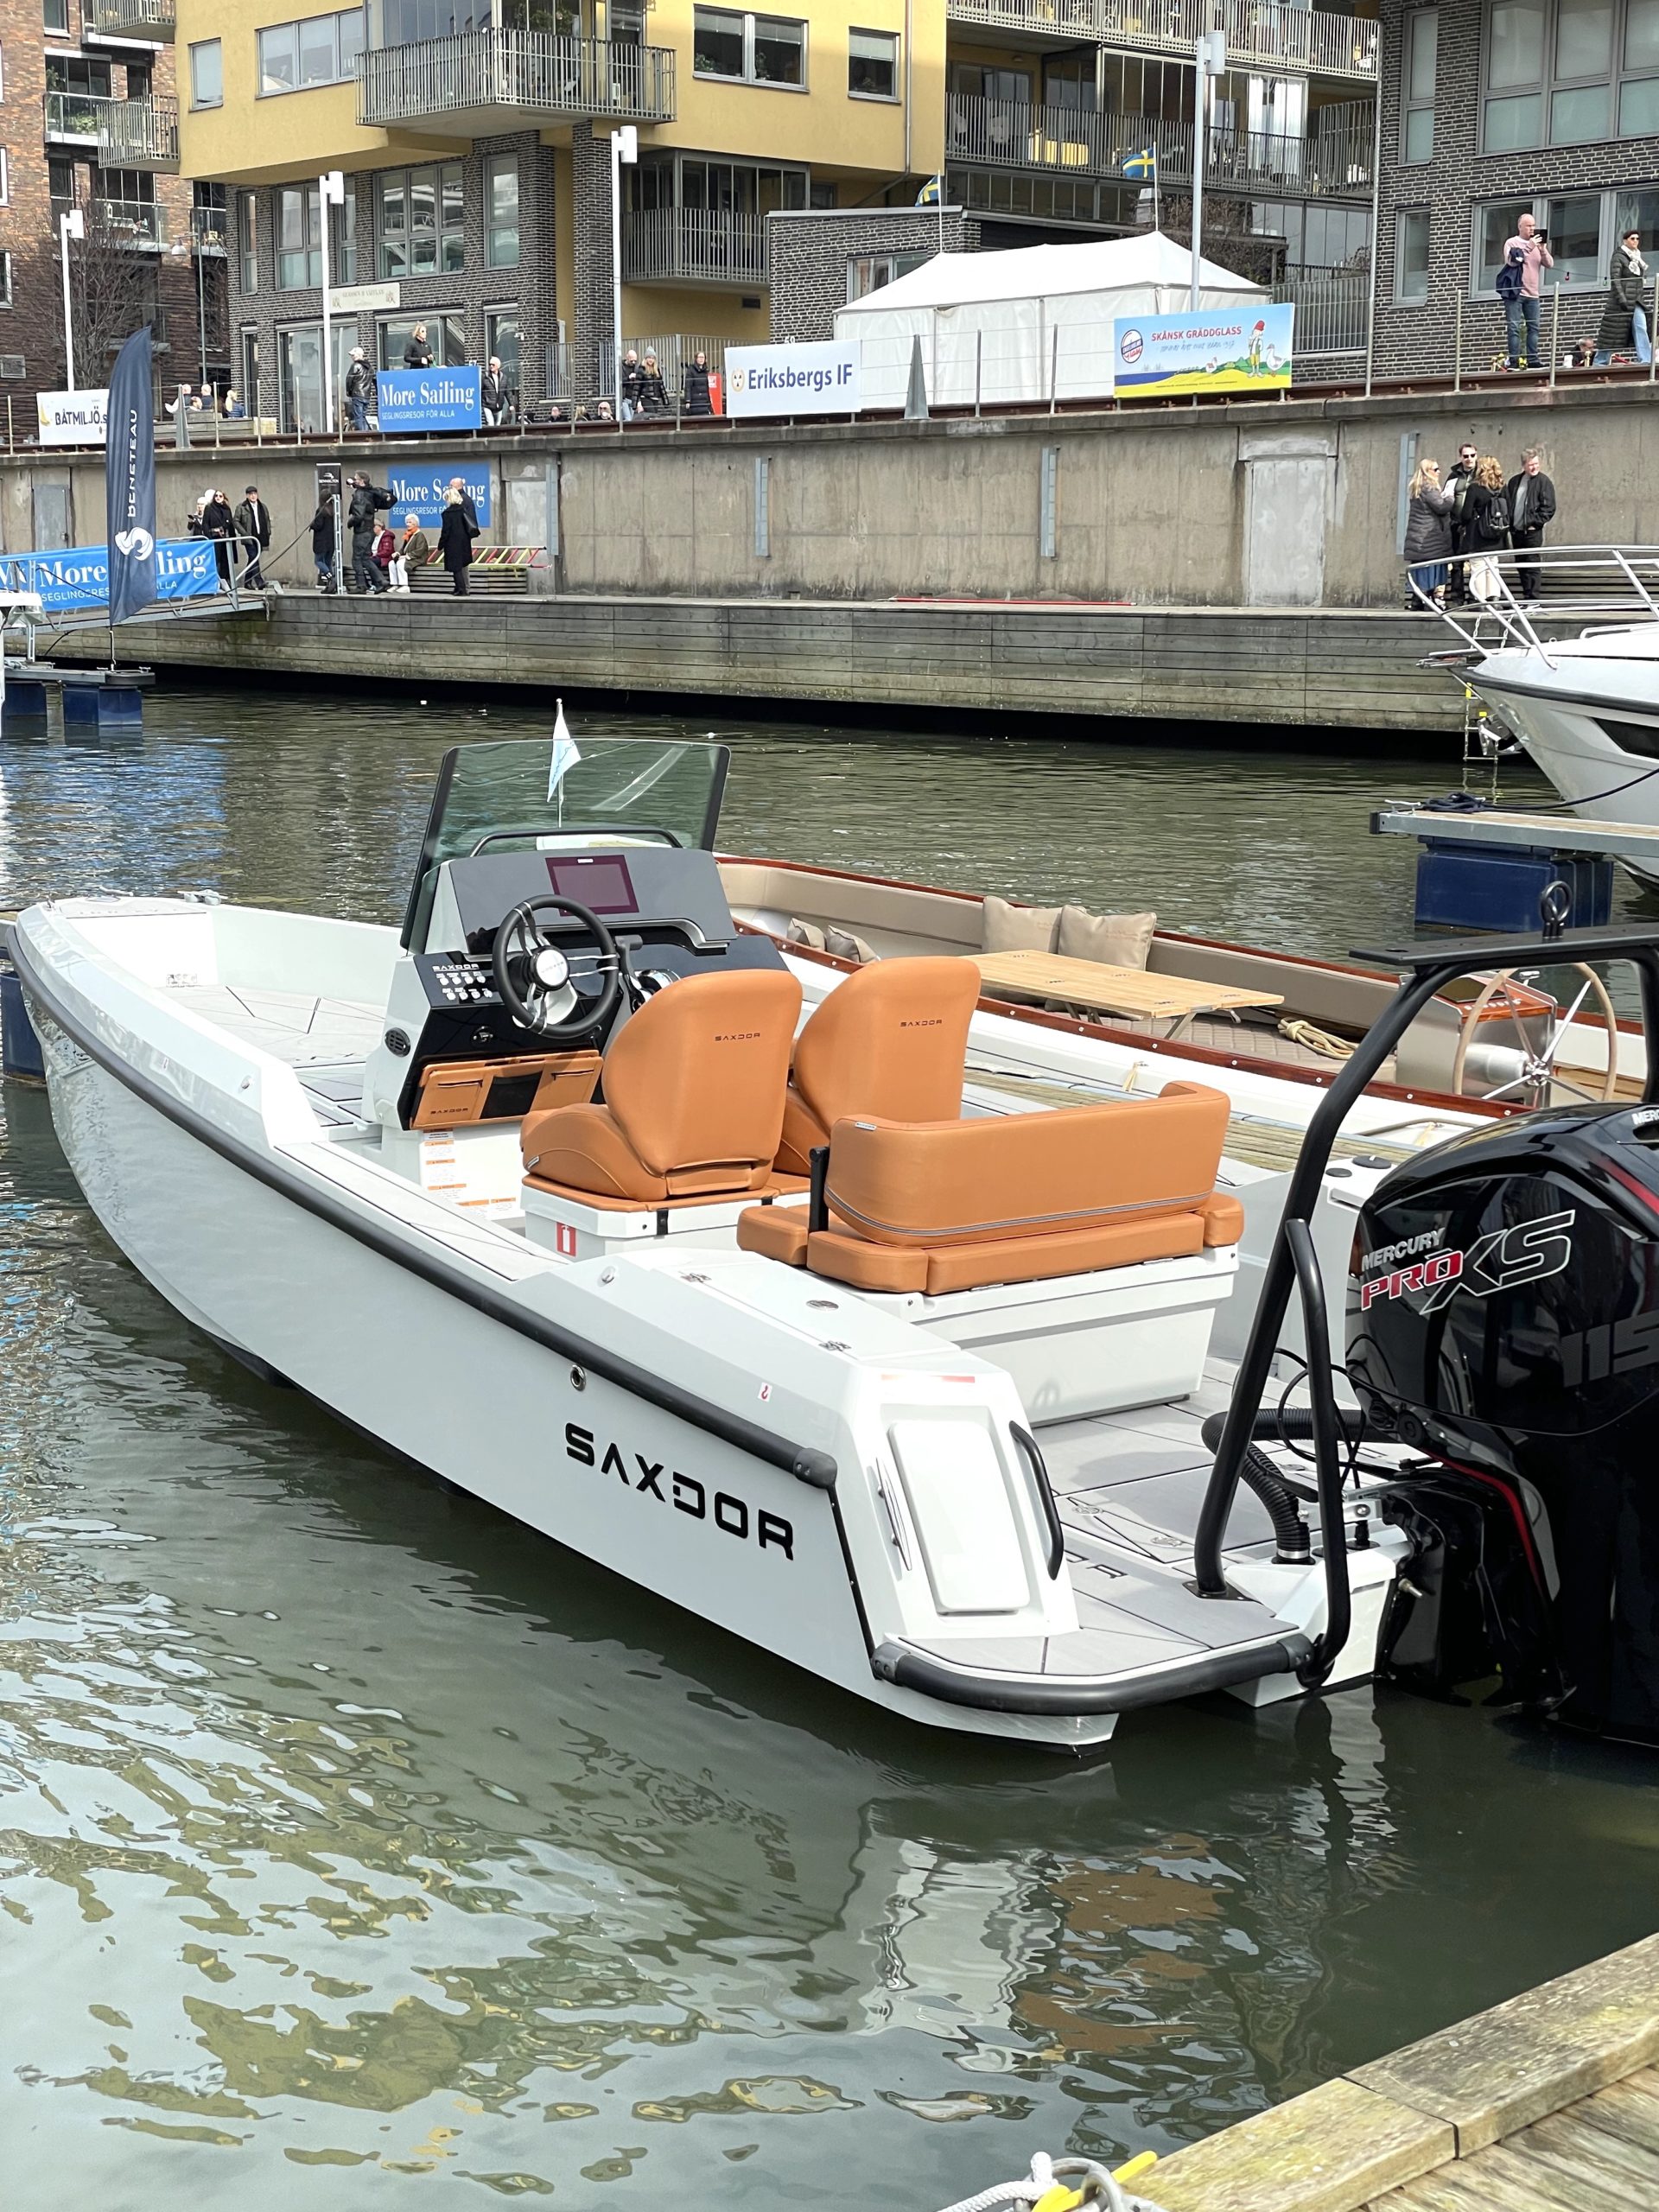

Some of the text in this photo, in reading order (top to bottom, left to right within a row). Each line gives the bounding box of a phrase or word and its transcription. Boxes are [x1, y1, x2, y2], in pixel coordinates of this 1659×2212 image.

[1151, 326, 1242, 341] SKÅNSK GRÄDDGLASS
[748, 364, 853, 392] Eriksbergs IF
[381, 380, 475, 411] More Sailing
[54, 405, 108, 426] BÅTMILJÖ.s
[382, 409, 455, 421] SEGLINGSRESOR FÖR ALLA
[127, 409, 137, 518] BENETEAU
[392, 480, 429, 502] More
[392, 506, 438, 515] SEGLINGSRESOR
[37, 561, 108, 588] More
[156, 550, 207, 580] ling
[41, 581, 178, 602] SEGLINGSRES LLA
[899, 1019, 943, 1027] SAXDOR
[715, 1033, 760, 1042] SAXDOR
[1362, 1227, 1446, 1272] MERCURY
[1361, 1209, 1576, 1316] PRO XS
[565, 1422, 794, 1561] SAXDOR
